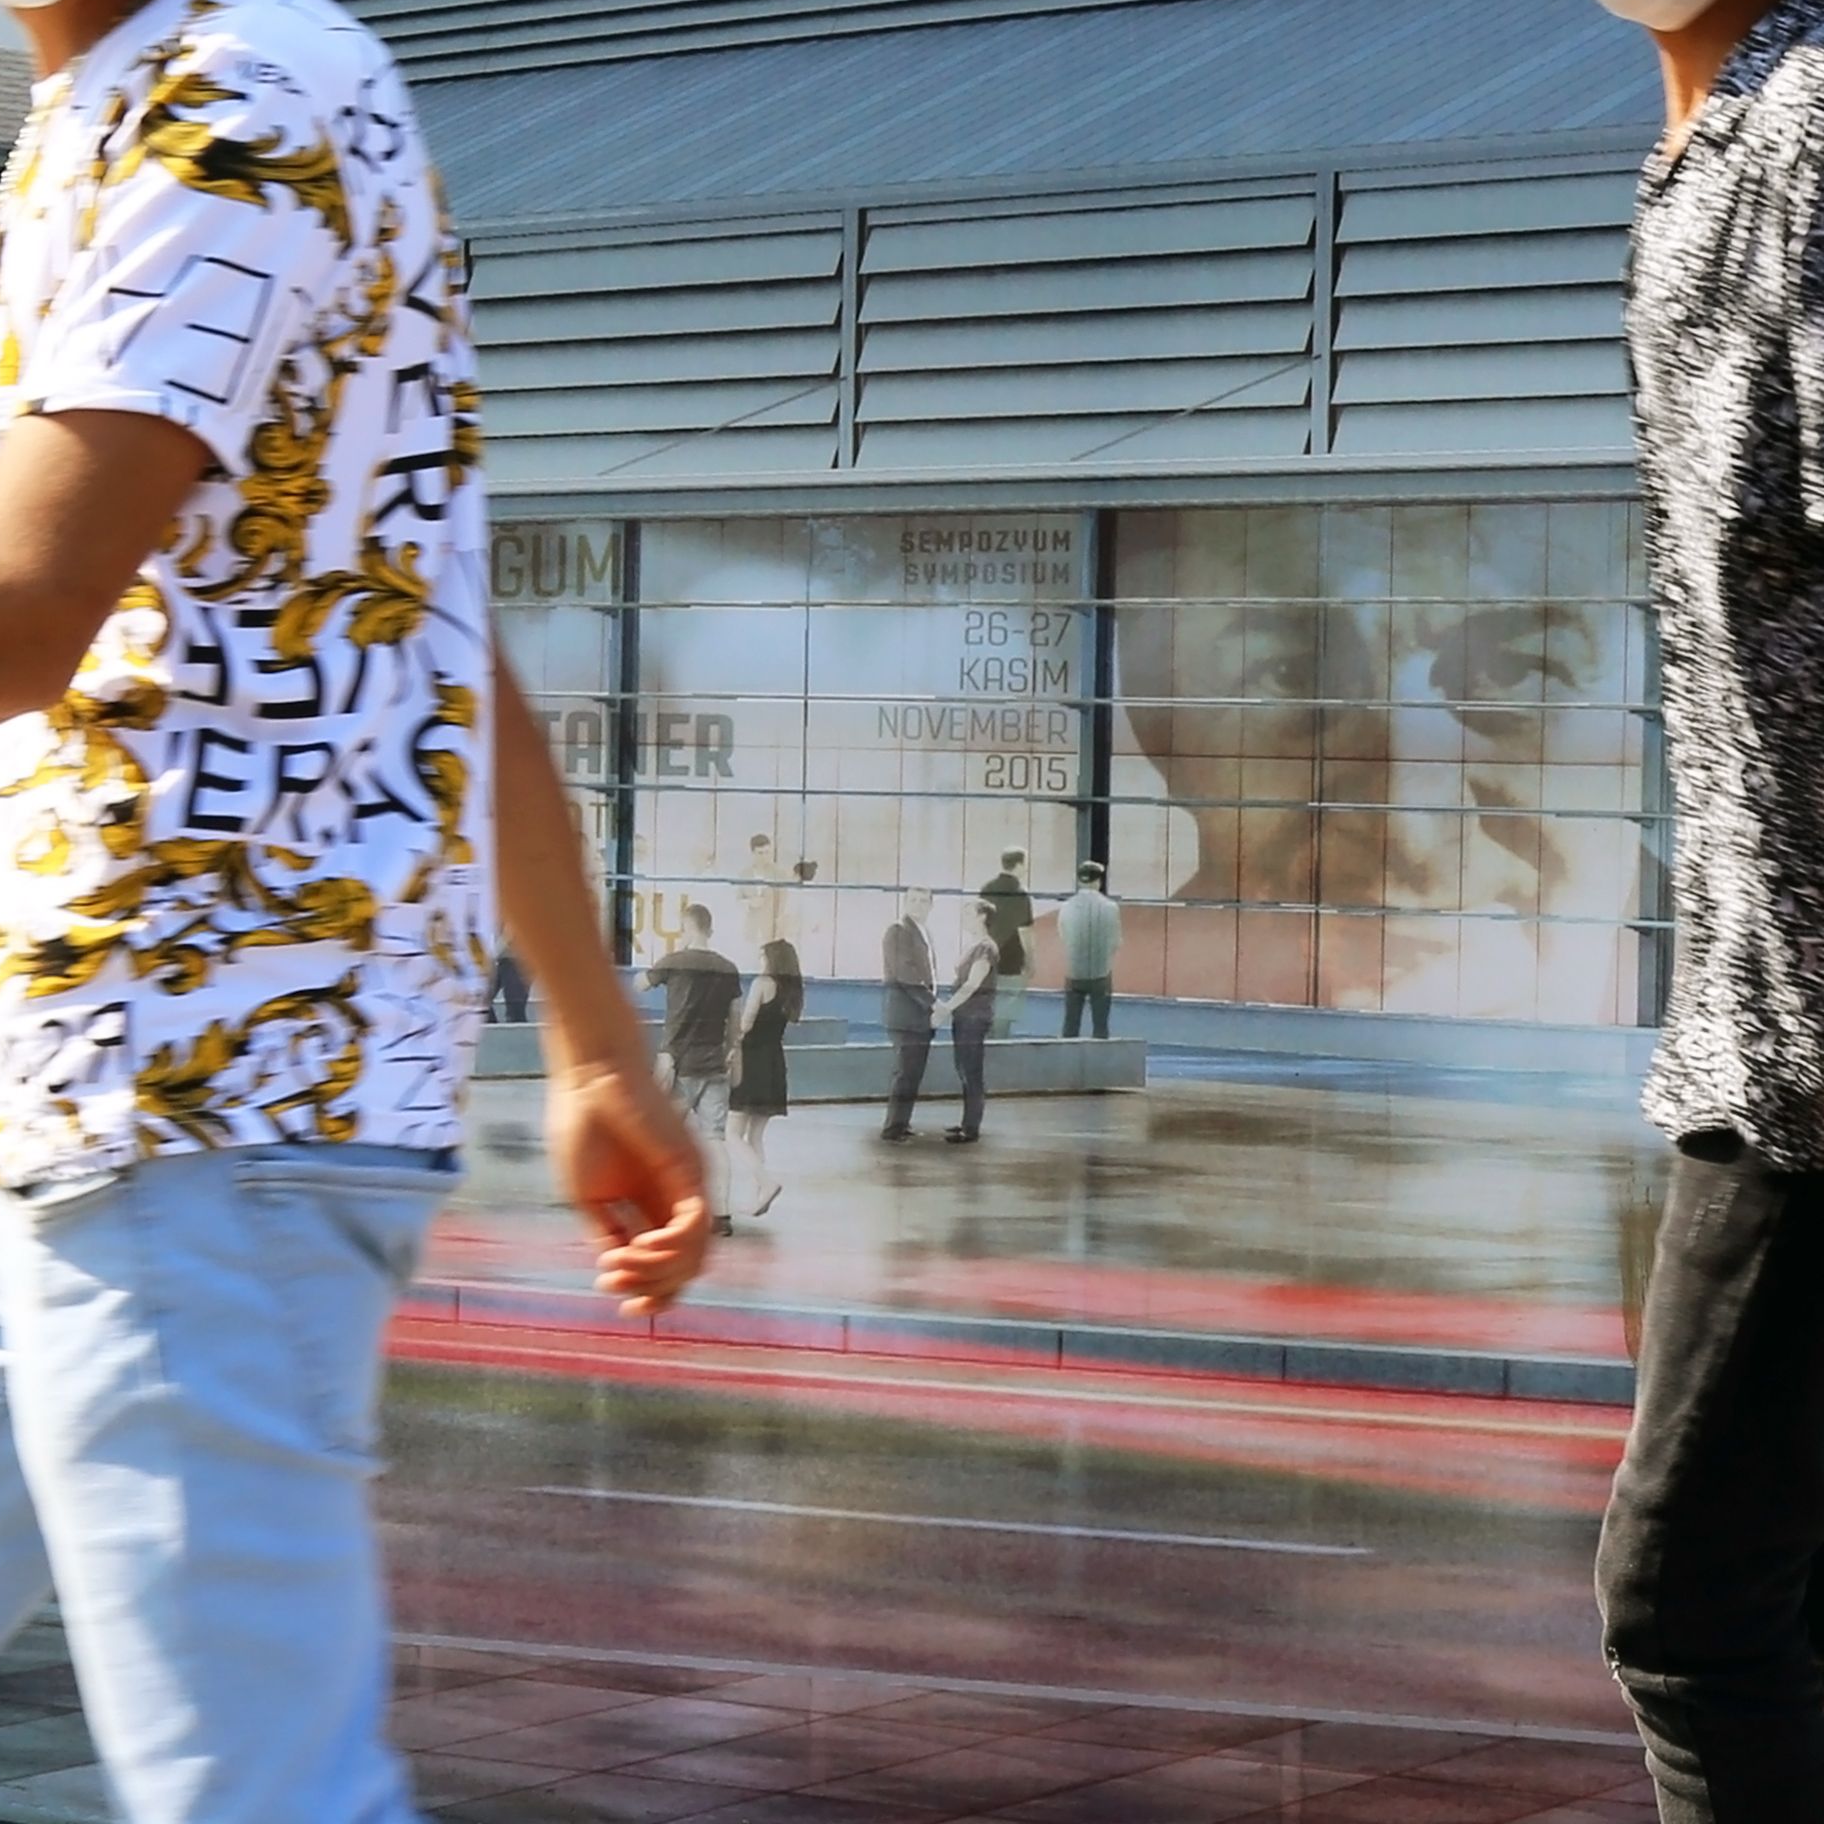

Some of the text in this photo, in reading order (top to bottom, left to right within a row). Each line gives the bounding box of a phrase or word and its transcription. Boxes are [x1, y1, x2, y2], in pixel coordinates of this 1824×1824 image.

[899, 529, 1072, 554] SEMPOZYUM
[490, 526, 622, 599] ĞUM
[904, 560, 1072, 586] SYMPOSIUM
[964, 610, 1072, 648] 26-27
[959, 656, 1069, 695] KASIM
[877, 705, 1068, 745] NOVEMBER
[984, 755, 1067, 792] 2015
